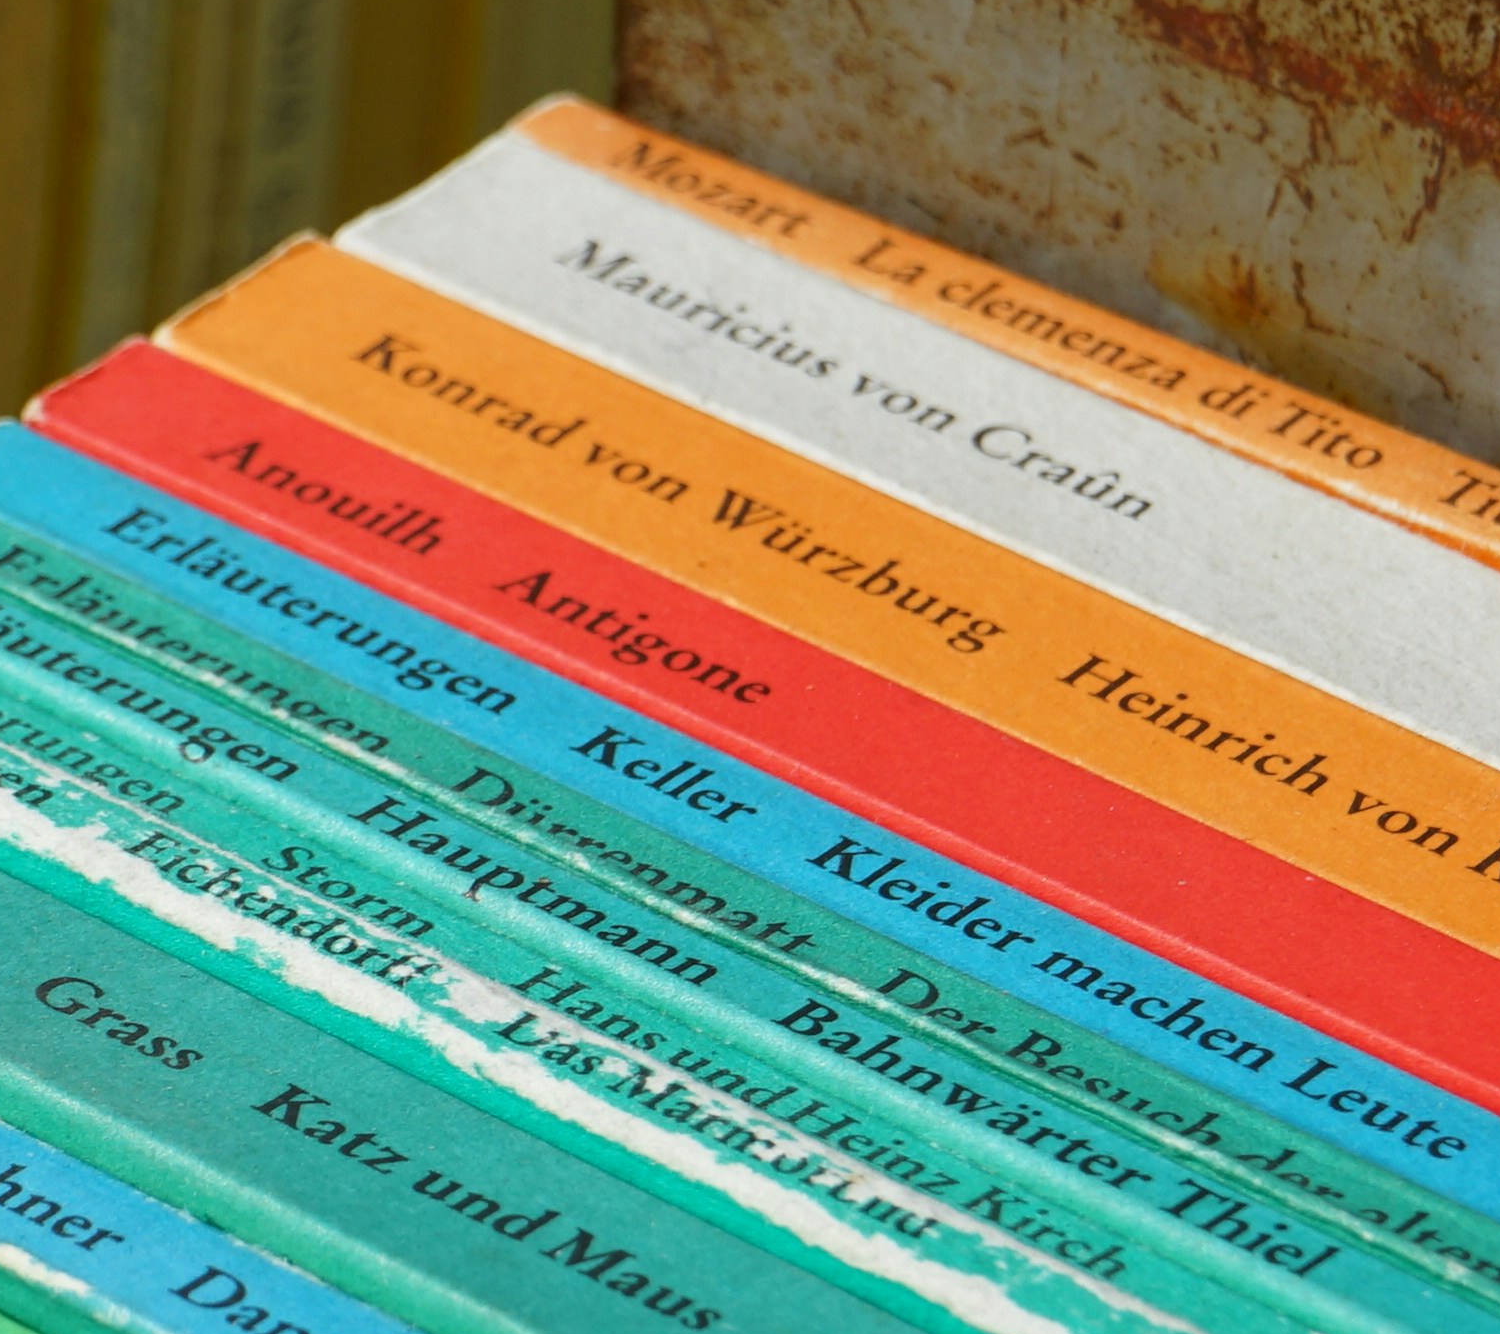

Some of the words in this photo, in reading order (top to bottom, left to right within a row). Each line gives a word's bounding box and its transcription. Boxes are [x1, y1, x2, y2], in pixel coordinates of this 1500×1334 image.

[555, 237, 840, 381] Mauricius
[849, 372, 958, 435] von
[970, 422, 1155, 523] Craûn
[612, 141, 812, 239] Mozart
[848, 237, 928, 291] La
[936, 269, 1186, 391] clemenza
[1198, 375, 1256, 420] di
[1268, 399, 1385, 472] Tito
[204, 436, 449, 558] Anouilh
[495, 567, 774, 708] Antigone
[351, 332, 589, 449] Konrad
[585, 440, 688, 505] von
[710, 486, 1008, 655] Würzburg
[1057, 652, 1330, 798] Heinrich
[1347, 789, 1461, 858] von
[104, 505, 519, 718] Erläuterungen
[570, 724, 760, 827] Keller
[804, 834, 1037, 953] Kleider
[1032, 948, 1281, 1074] machen
[1283, 1057, 1468, 1164] Leute
[121, 828, 446, 990] Eichendorff
[450, 765, 820, 953] Dürrenmatt
[876, 966, 997, 1047] Der
[33, 974, 204, 1071] Grass
[250, 1082, 412, 1175] Katz
[410, 1169, 564, 1244] und
[541, 1205, 727, 1334] Maus
[260, 843, 438, 943] Storm
[509, 964, 671, 1055] Hans
[669, 1047, 797, 1123] und
[788, 1096, 961, 1198] Heinz
[963, 1183, 1130, 1284] Kirch
[347, 794, 720, 989] Hauptmann
[772, 996, 1151, 1194] Bahnwärter
[1157, 1176, 1342, 1278] Thiel
